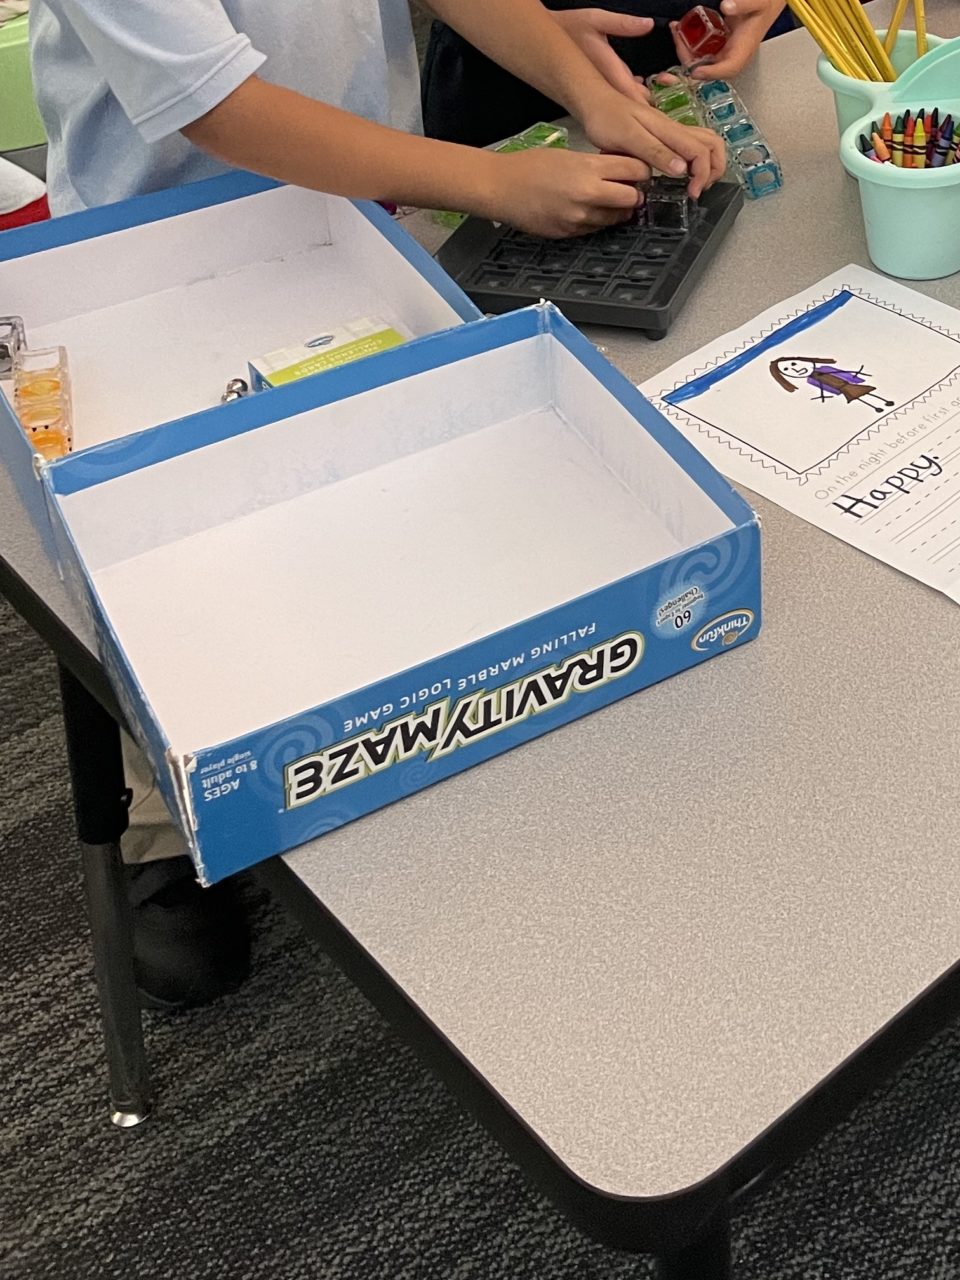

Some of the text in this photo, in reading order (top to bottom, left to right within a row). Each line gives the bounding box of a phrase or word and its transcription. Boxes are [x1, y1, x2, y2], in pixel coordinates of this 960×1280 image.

[814, 485, 837, 500] On
[836, 469, 858, 487] the
[858, 448, 889, 472] night
[885, 422, 927, 450] before
[924, 406, 950, 429] first
[674, 609, 692, 629] 60
[343, 622, 597, 733] FALLING MARBLE LOGIC GAME
[201, 760, 258, 789] 8 to adult
[204, 778, 240, 801] AGES
